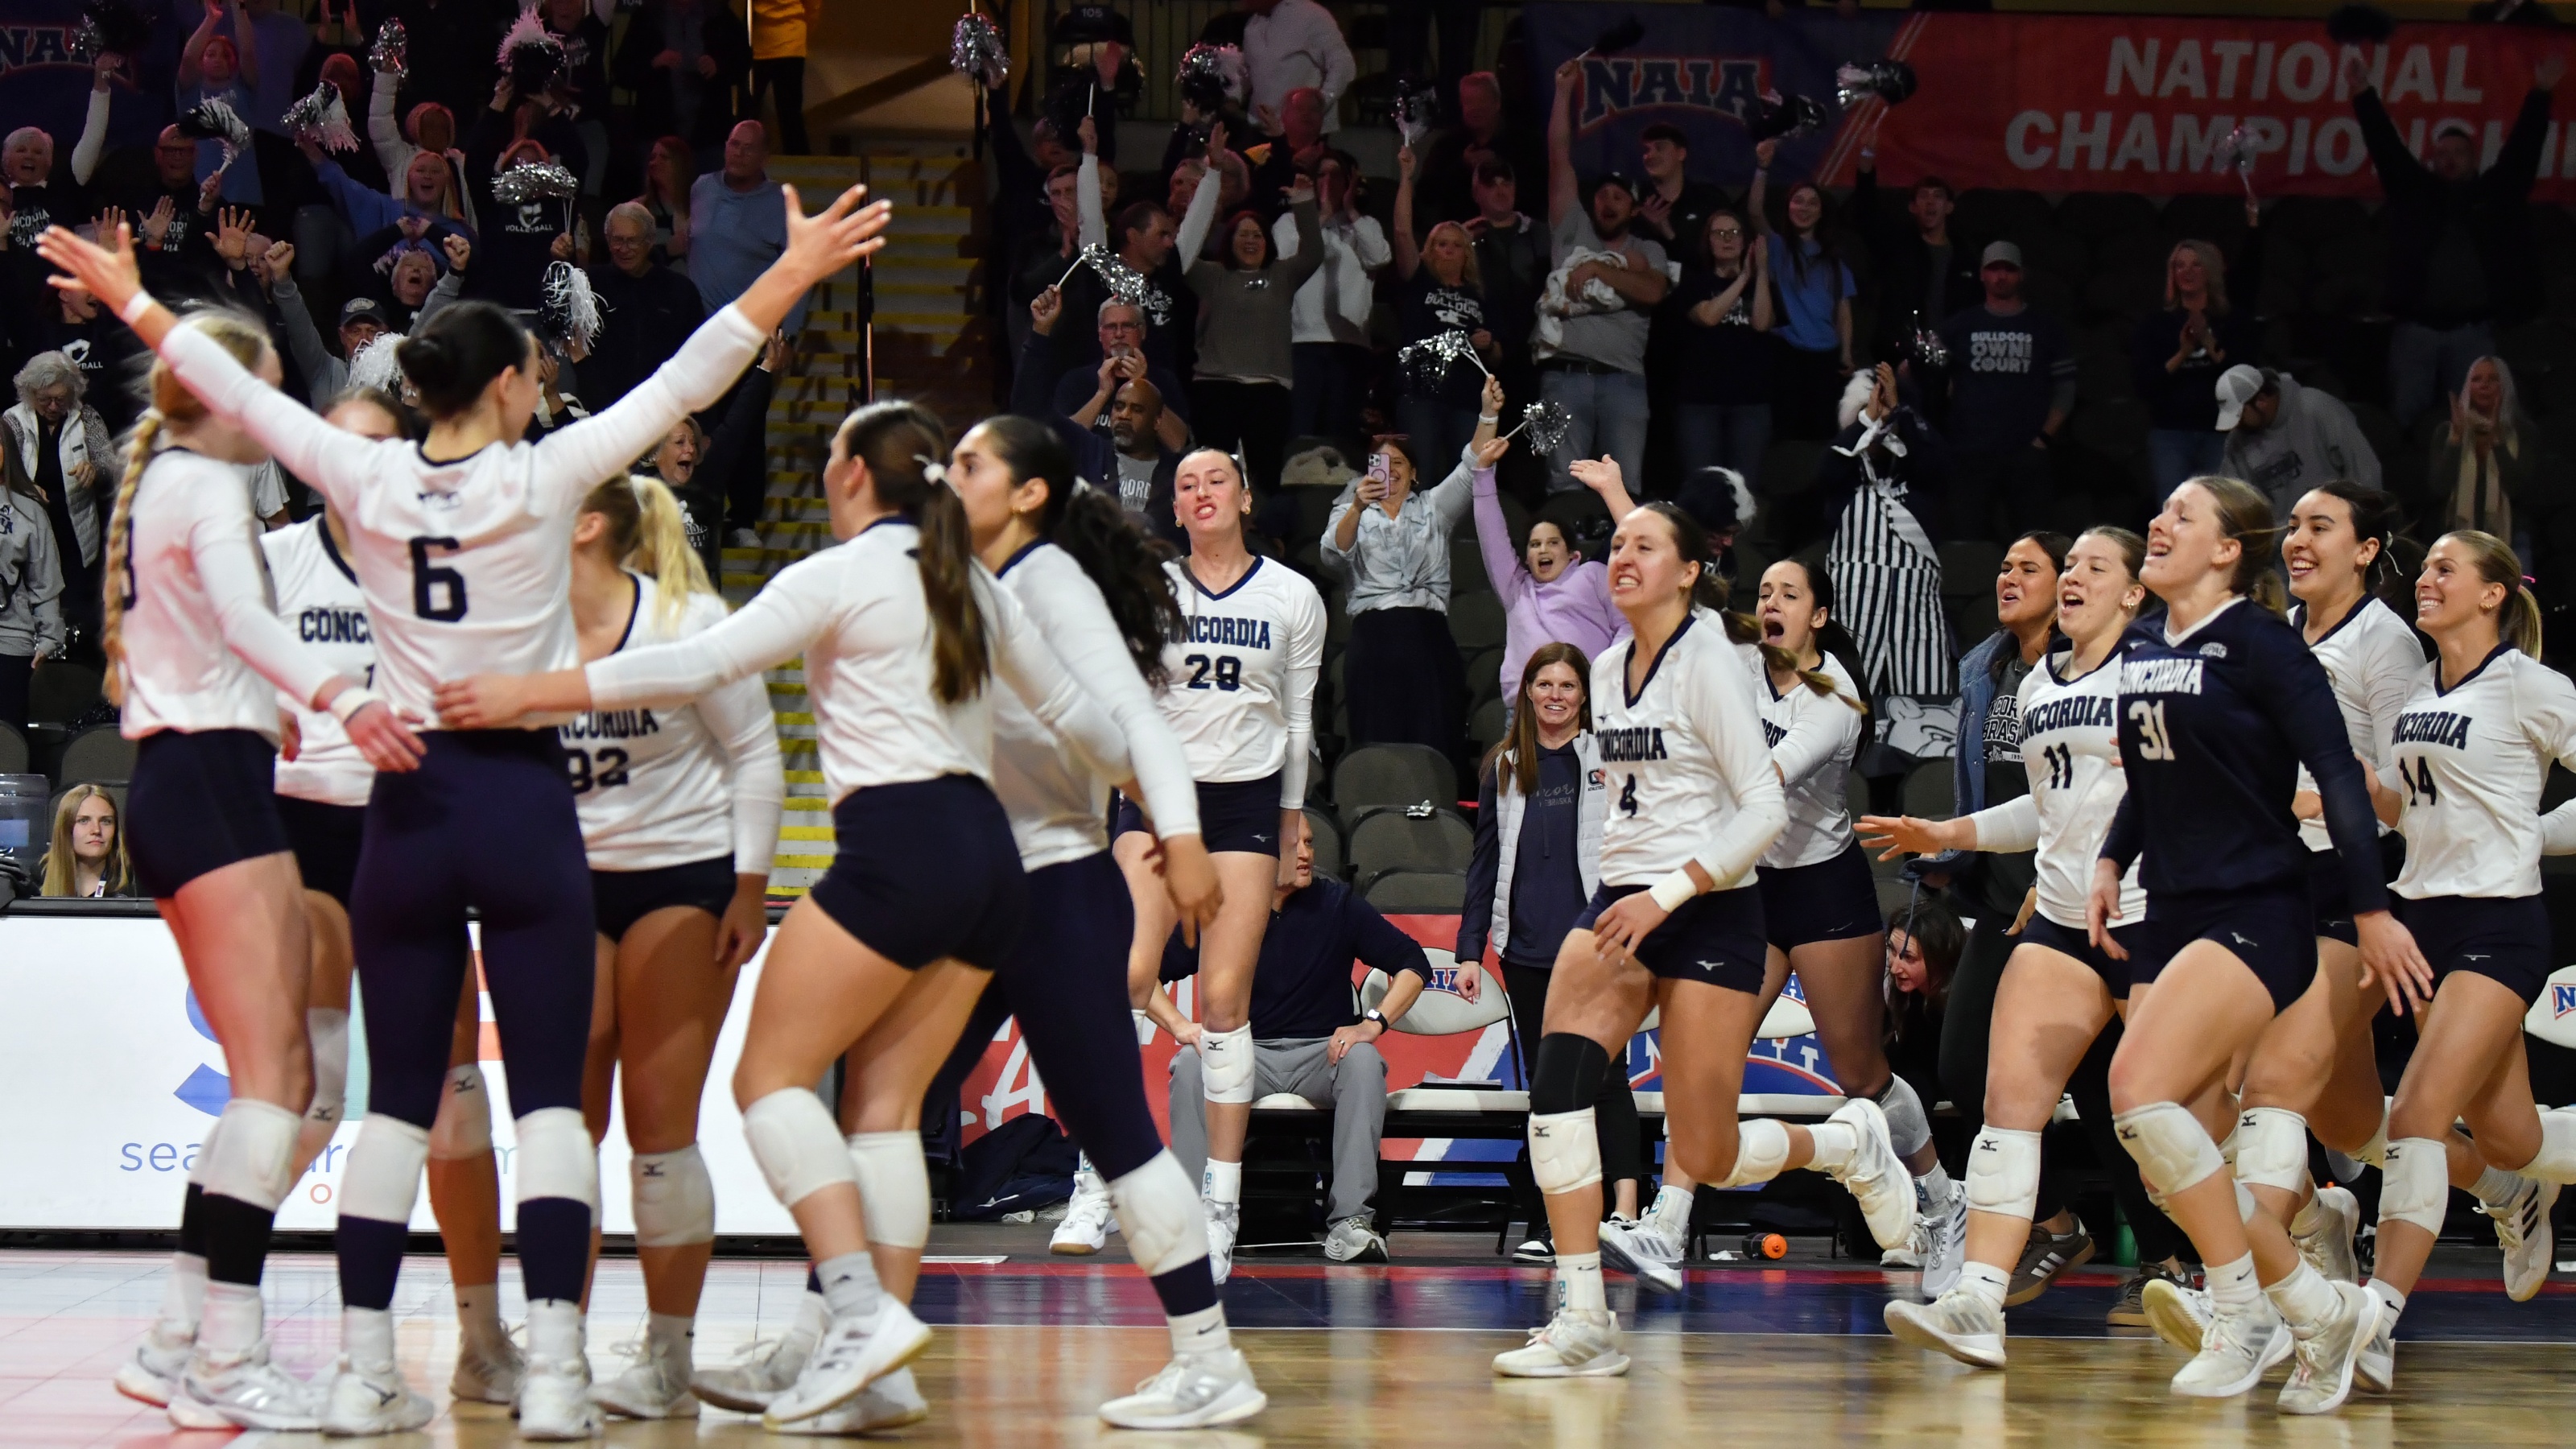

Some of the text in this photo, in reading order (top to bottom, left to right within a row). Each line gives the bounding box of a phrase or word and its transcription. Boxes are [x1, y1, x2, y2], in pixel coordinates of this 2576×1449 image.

[1080, 7, 1104, 18] 105
[1580, 56, 1763, 129] NAIA
[2103, 36, 2483, 105] NATIONAL
[505, 222, 554, 234] VOLLEYBALL
[1971, 331, 2033, 342] BULLDOGS
[1970, 356, 2031, 374] COURT
[409, 535, 469, 623] 6
[2128, 699, 2175, 761] 31
[2043, 741, 2073, 790] 11
[2399, 755, 2437, 807] 14
[1619, 772, 1637, 819] 4
